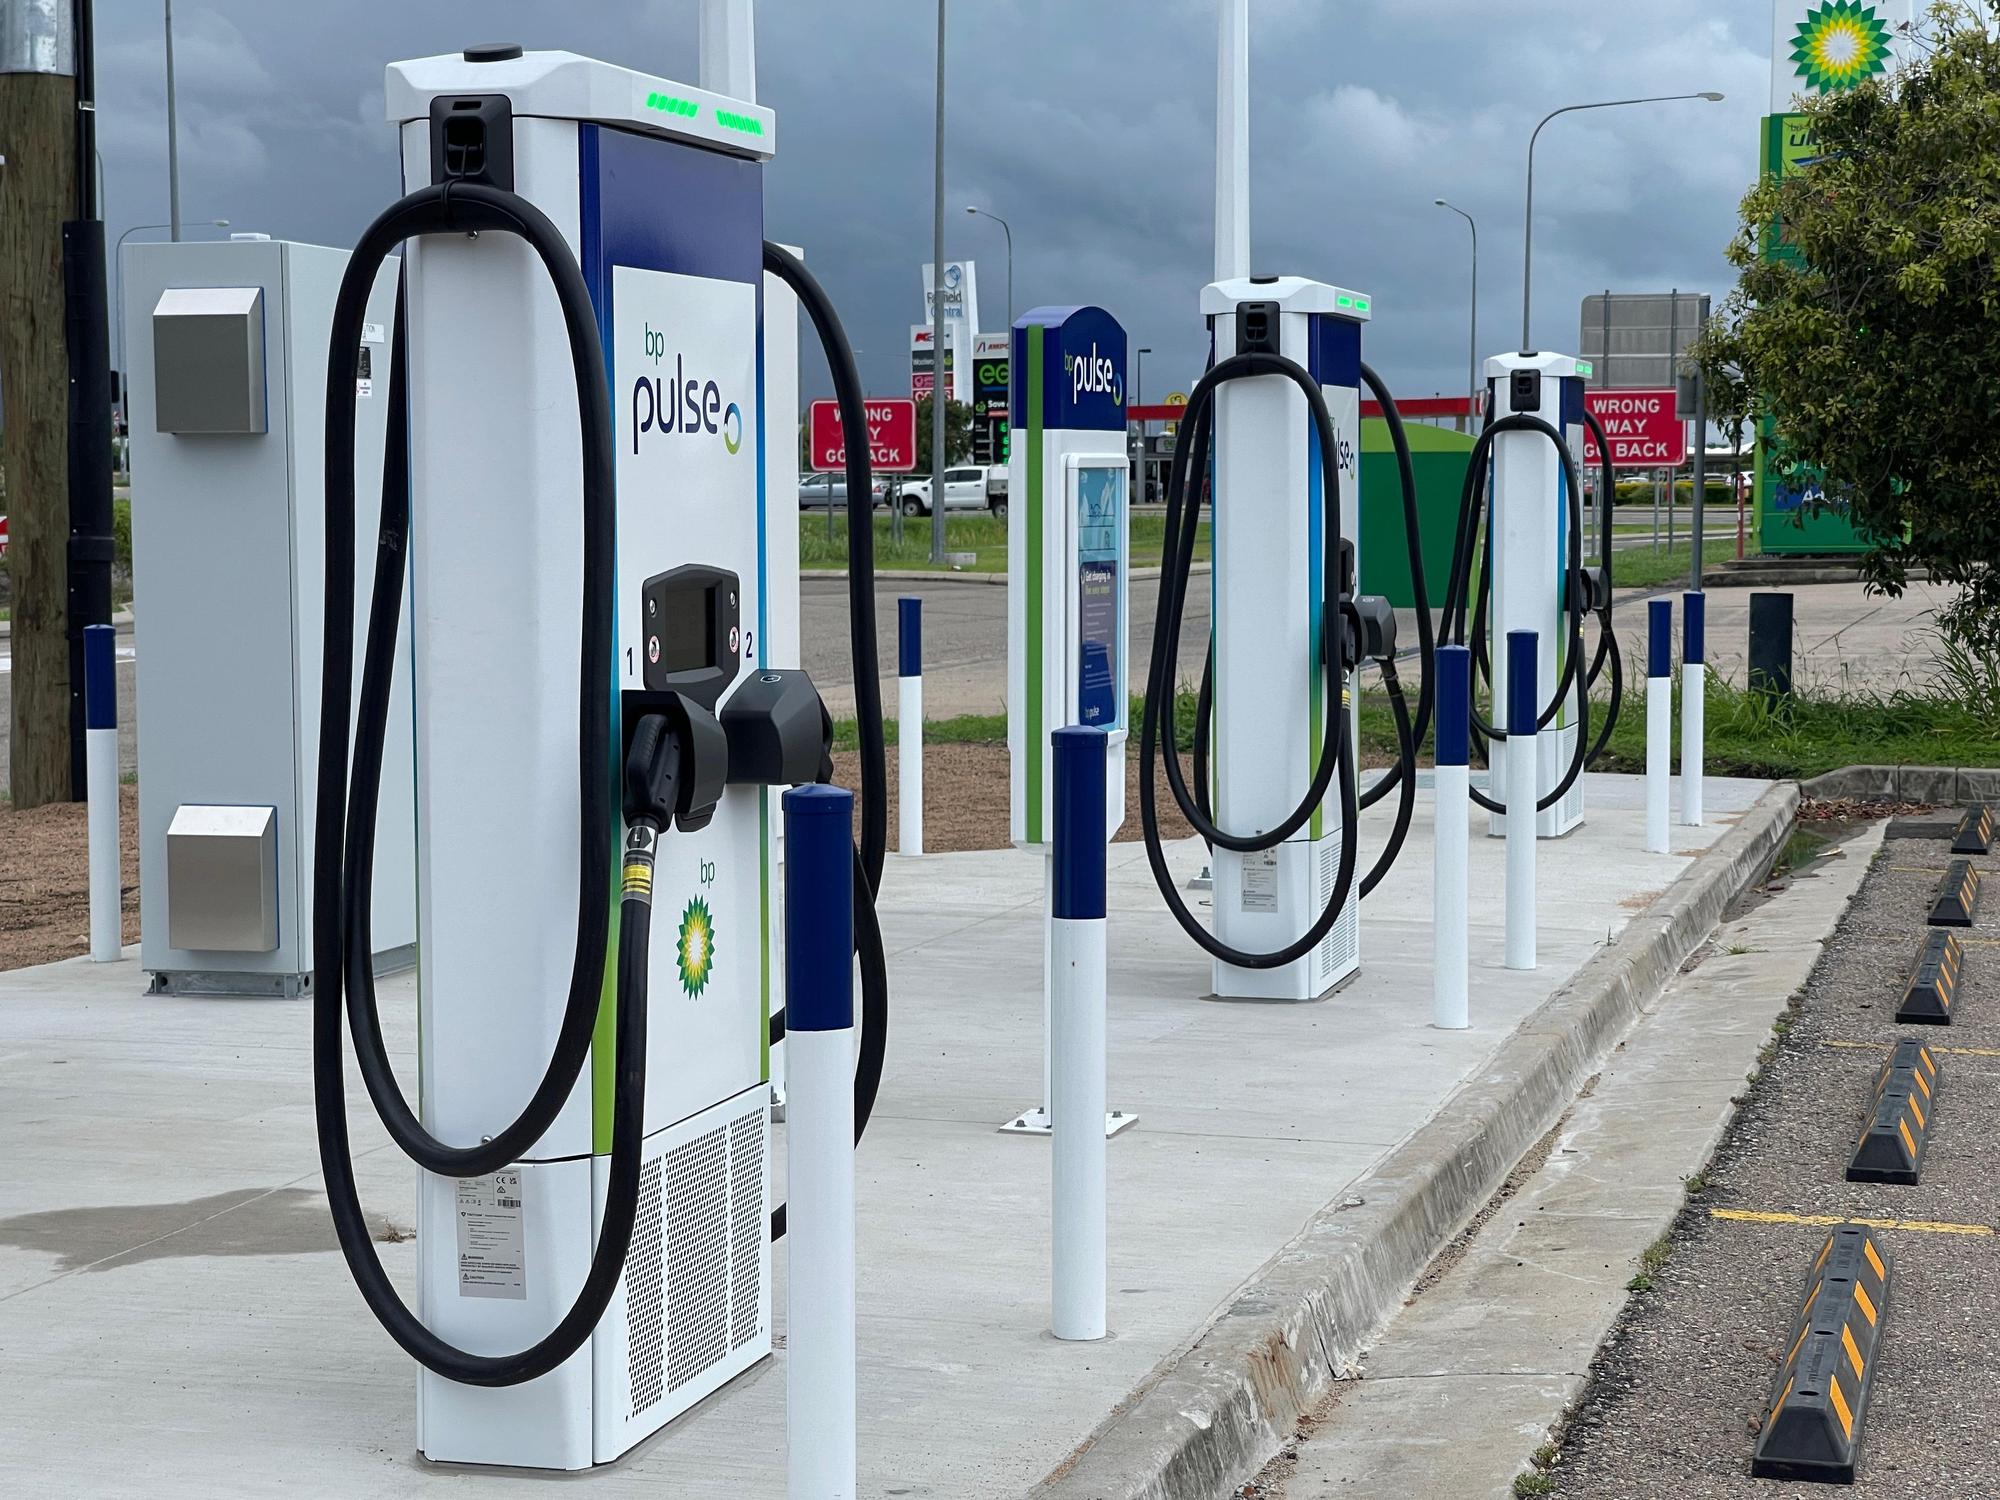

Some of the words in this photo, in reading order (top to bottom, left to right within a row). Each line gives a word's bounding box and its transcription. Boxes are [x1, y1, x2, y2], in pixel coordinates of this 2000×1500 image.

[645, 321, 665, 366] bp
[1064, 349, 1074, 377] bp
[1073, 341, 1113, 405] pulse
[632, 352, 721, 455] pulse
[1592, 398, 1661, 414] WRONG
[1604, 418, 1648, 434] WAY
[1336, 426, 1350, 470] lse
[1615, 441, 1669, 458] BACK
[745, 631, 753, 658] 2
[626, 647, 633, 676] 1
[634, 834, 641, 842] L
[700, 857, 715, 889] bp
